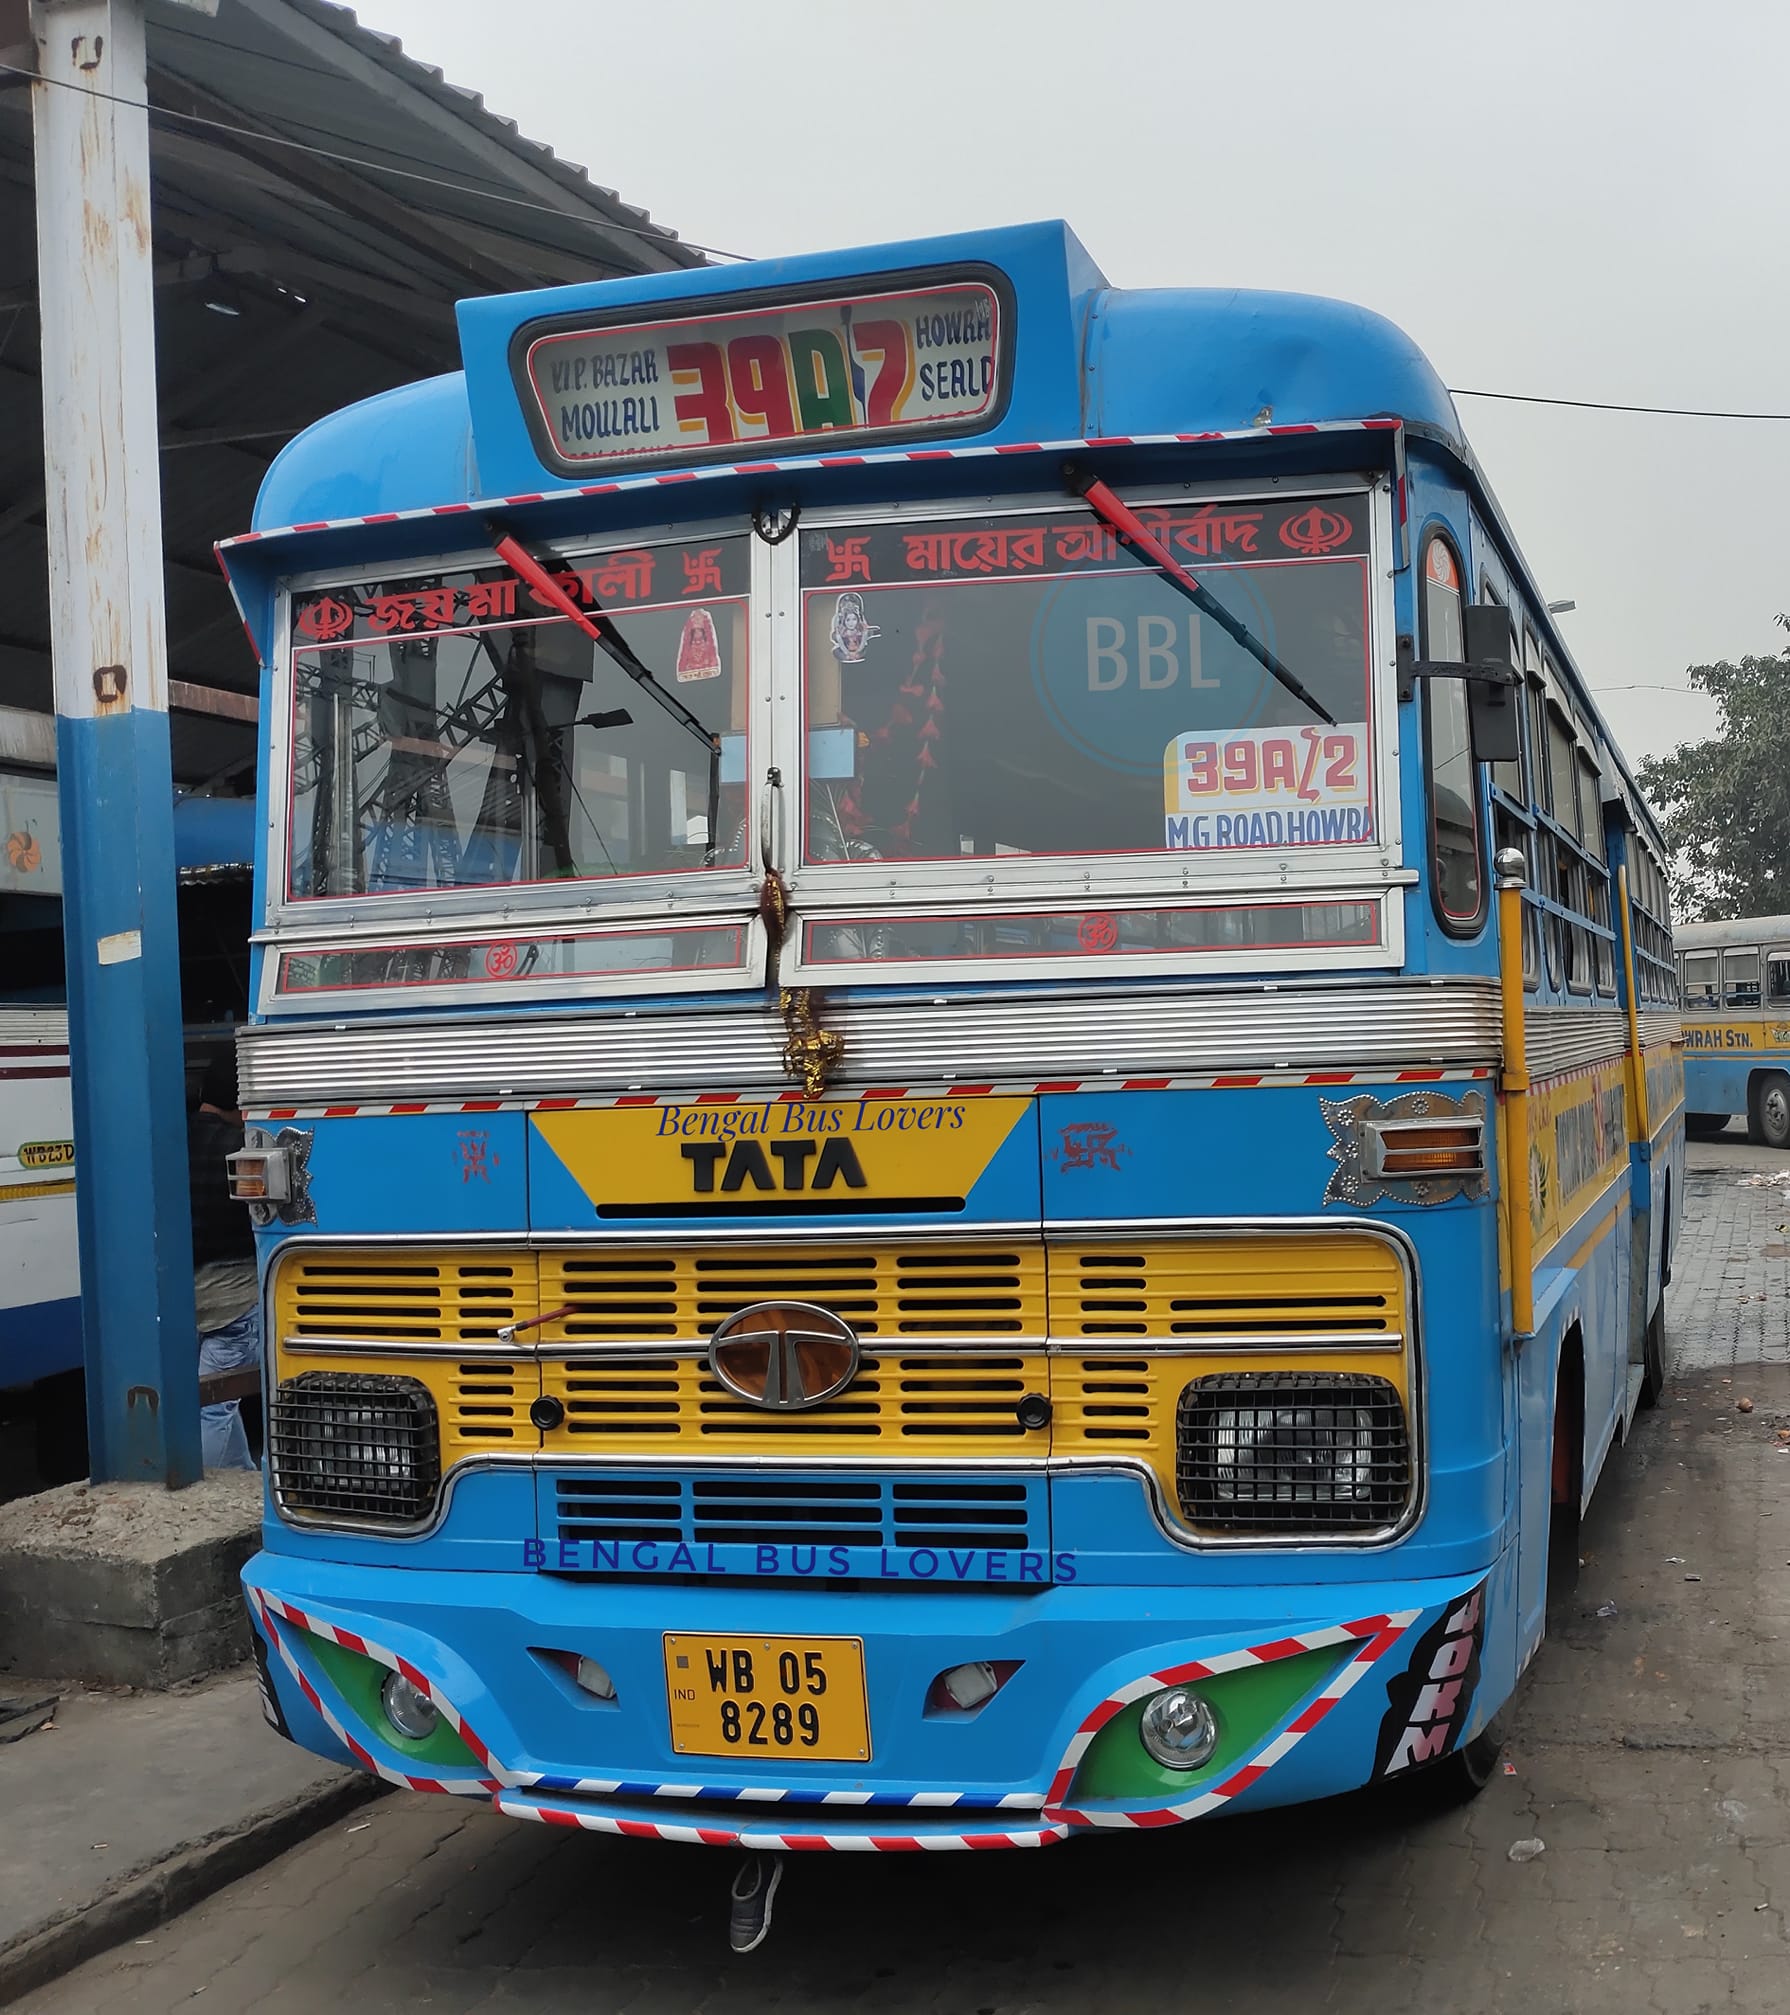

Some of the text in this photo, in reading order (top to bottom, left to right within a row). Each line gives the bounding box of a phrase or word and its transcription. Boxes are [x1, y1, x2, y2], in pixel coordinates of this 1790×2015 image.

[591, 348, 659, 389] BAZAR
[560, 396, 660, 442] MOULALI
[902, 527, 1047, 573] মায়ের
[364, 587, 458, 632] জয়
[464, 579, 519, 617] মা
[1185, 727, 1358, 804] 39A/2
[681, 1137, 868, 1192] TATA
[674, 1689, 696, 1701] IND
[705, 1649, 827, 1696] WB 05
[720, 1700, 820, 1747] 8289
